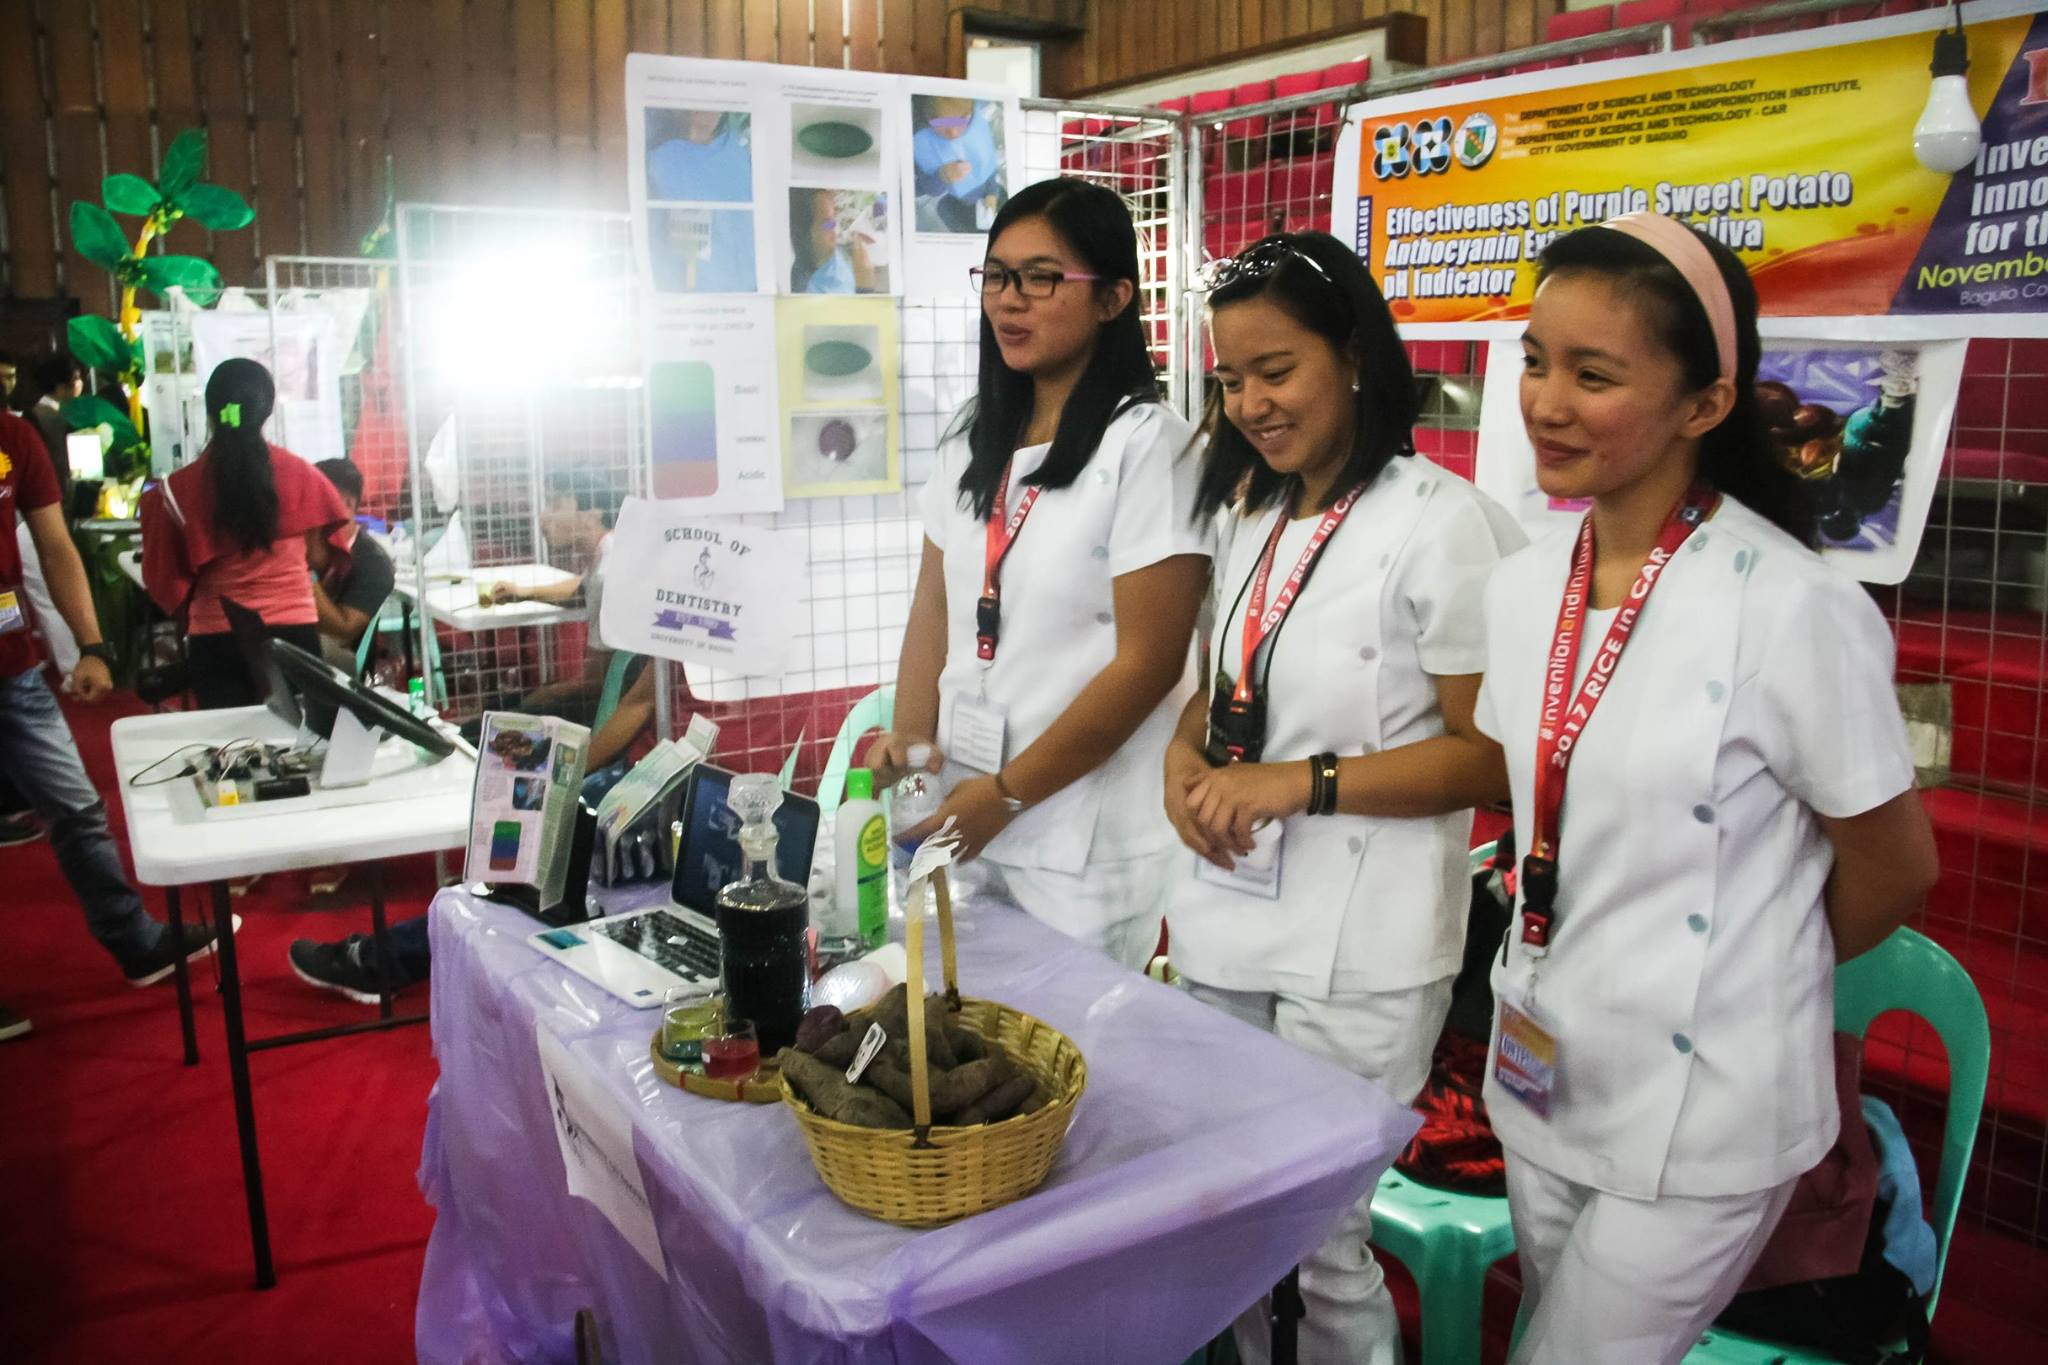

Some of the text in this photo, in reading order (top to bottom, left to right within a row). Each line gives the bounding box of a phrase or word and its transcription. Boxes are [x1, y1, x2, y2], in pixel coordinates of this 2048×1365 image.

[1519, 103, 1584, 121] DEPARTMENT
[1586, 101, 1600, 111] OF
[1602, 94, 1648, 109] SCIENCE
[1650, 90, 1673, 102] AND
[1675, 79, 1756, 98] TECHNOLOGY
[1547, 112, 1613, 129] TECHNOLOGY
[1615, 103, 1687, 120] APPLICATION
[1515, 128, 1581, 146] DEPARTMENT
[1583, 126, 1597, 137] OF
[1599, 121, 1644, 136] SCIENCE
[1647, 117, 1670, 128] AND
[1672, 108, 1752, 126] TECHNOLOGY
[1760, 104, 1788, 117] CAR
[1529, 145, 1552, 156] CITY
[1554, 136, 1626, 154] GOVERNMENT
[1628, 134, 1643, 145] OF
[1646, 129, 1688, 144] BAGUIO
[1385, 199, 1529, 236] Effectiveness
[1535, 192, 1559, 225] of
[1655, 179, 1742, 214] Sweet
[1750, 171, 1852, 210] Potato
[1384, 232, 1520, 268] Anthocyanin
[1964, 220, 2018, 255] for
[1383, 266, 1516, 301] pH Indicator
[1916, 251, 2048, 291] Novemb
[1960, 287, 2018, 307] Baguio
[1006, 496, 1033, 538] 2017
[663, 527, 752, 557] SCHOOL OF
[656, 588, 743, 618] DENTISTRY
[1260, 589, 1294, 634] 2017
[1291, 538, 1322, 585] RICE
[1551, 702, 1588, 769] 2017
[1583, 638, 1623, 699] RICE
[1630, 546, 1673, 601] CAR
